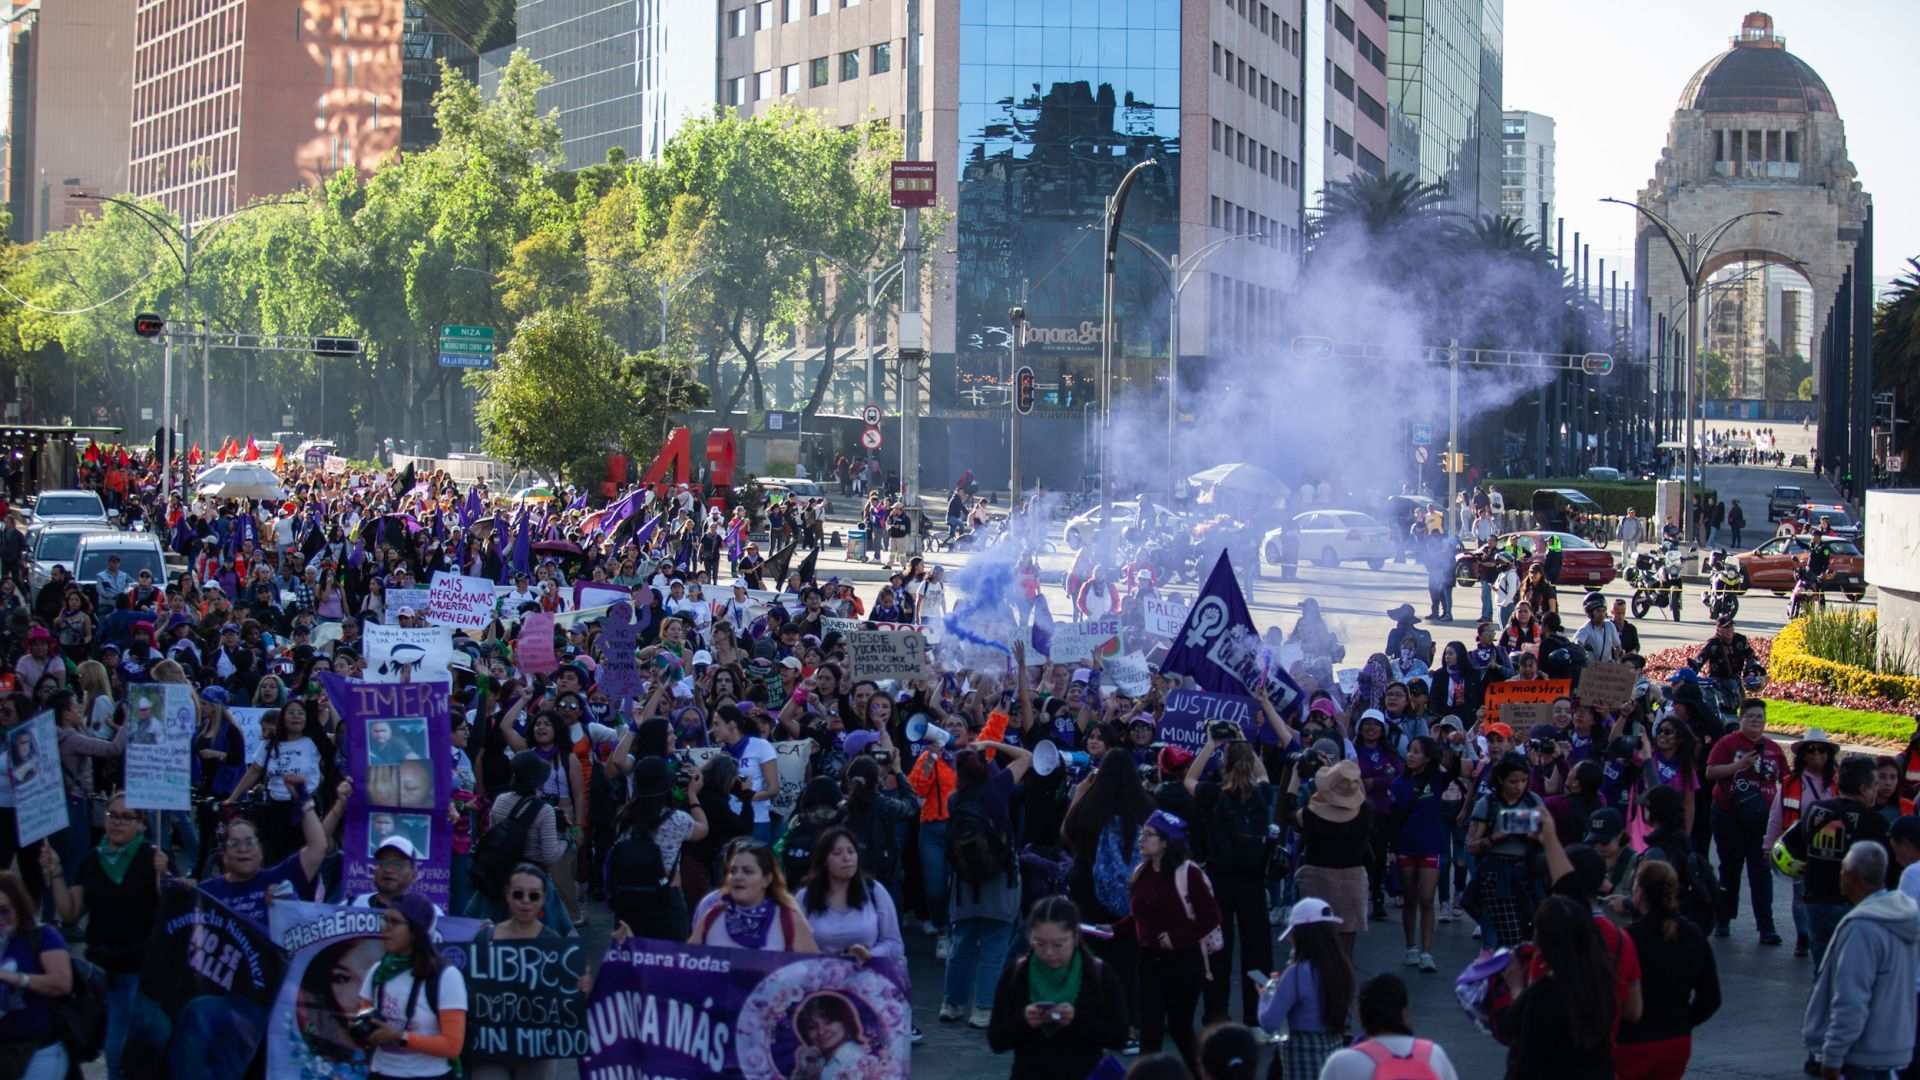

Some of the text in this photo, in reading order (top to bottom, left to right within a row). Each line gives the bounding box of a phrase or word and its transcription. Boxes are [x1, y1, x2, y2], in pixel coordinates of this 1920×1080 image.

[461, 328, 481, 337] NIZA
[440, 578, 463, 592] MIS
[428, 600, 473, 612] MUERTAS
[430, 588, 494, 607] HERMANAS
[1079, 621, 1119, 636] LIBRE
[849, 632, 889, 644] DESDE
[1166, 693, 1250, 726] JUSTICIA
[1161, 727, 1208, 744] MONIC
[191, 924, 243, 972] NO SE
[189, 948, 236, 992] ALLA
[632, 951, 674, 967] para
[678, 952, 731, 973] Todas
[666, 996, 730, 1073] MÁS
